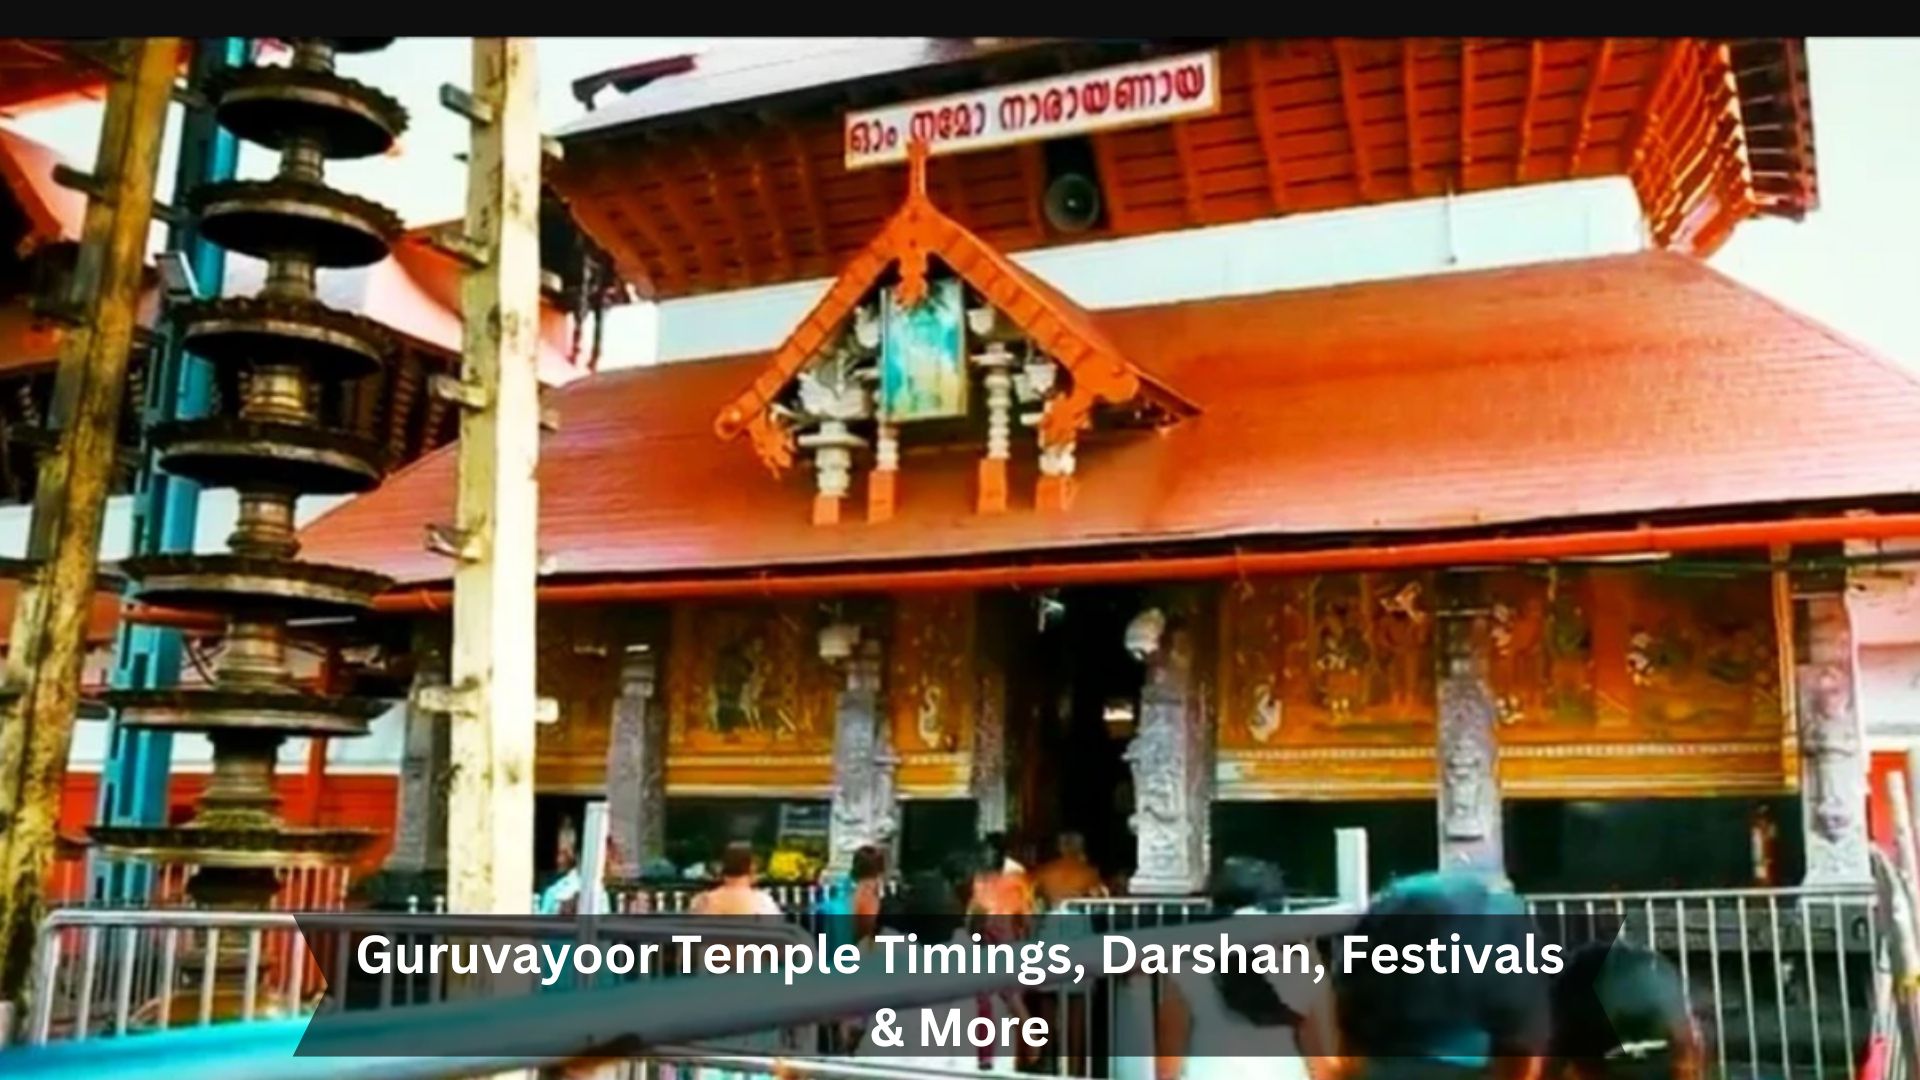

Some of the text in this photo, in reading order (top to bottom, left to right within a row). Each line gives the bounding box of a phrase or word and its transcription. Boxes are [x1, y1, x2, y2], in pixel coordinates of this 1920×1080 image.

[850, 62, 1205, 154] ഓം നമോ നാരായണായ
